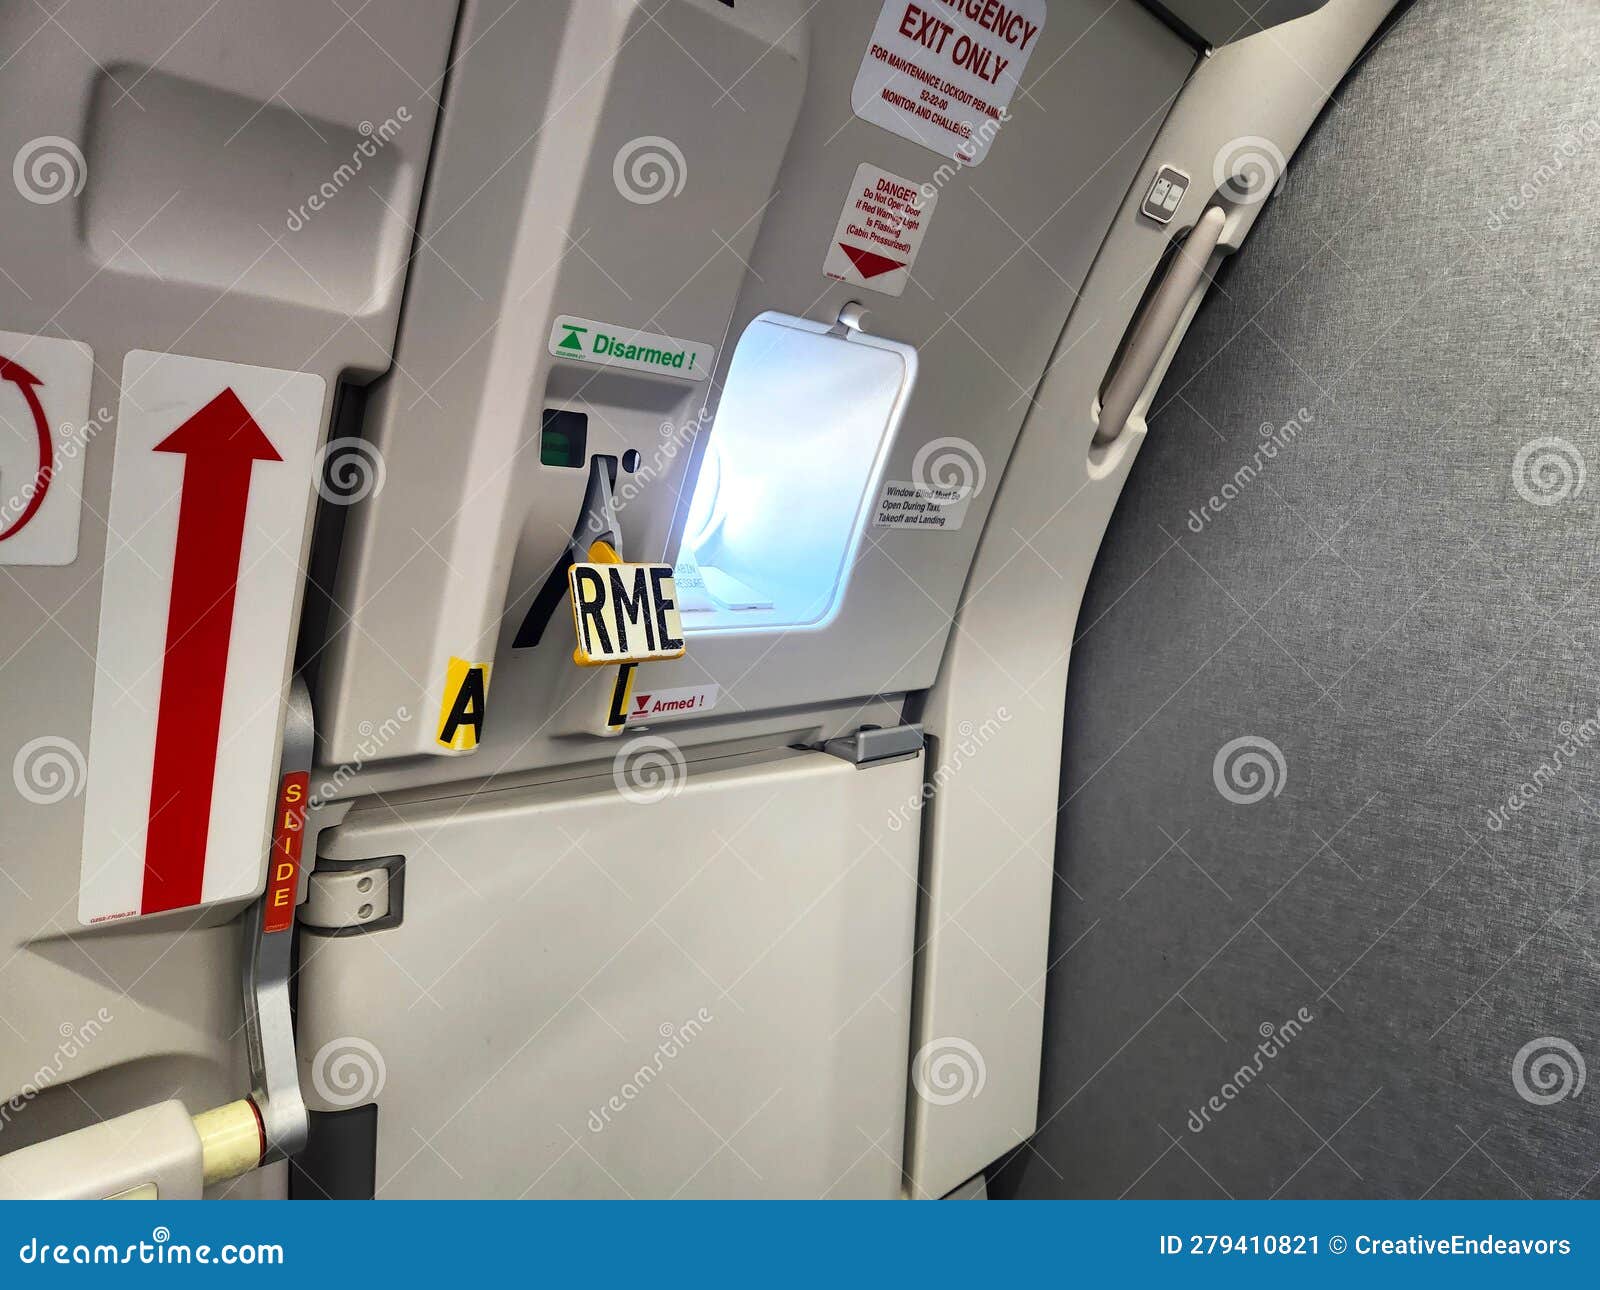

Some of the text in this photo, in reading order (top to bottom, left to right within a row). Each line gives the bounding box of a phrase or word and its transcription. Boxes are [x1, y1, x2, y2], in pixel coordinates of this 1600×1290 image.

[942, 0, 1037, 50] GENCY
[899, 3, 1008, 84] EXIT ONLY
[870, 44, 888, 63] FOR
[888, 53, 940, 89] MAINTENANCE
[940, 80, 973, 105] LOCKOUT
[973, 97, 986, 112] PER
[881, 89, 916, 113] MONITOR
[914, 103, 932, 121] AND
[920, 89, 948, 111] 52-22-00
[863, 188, 873, 200] Do
[875, 192, 886, 204] Not
[904, 205, 921, 217] Door
[876, 178, 917, 204] DANGER
[862, 201, 875, 214] Red
[902, 217, 919, 231] Light
[592, 333, 696, 370] Disarmed !
[882, 500, 901, 510] Open
[902, 501, 925, 513] During
[887, 486, 915, 498] Window
[878, 513, 946, 526] Takeoff and Landing
[575, 567, 684, 655] RME
[440, 668, 485, 745] A
[651, 696, 695, 713] Armed
[273, 783, 302, 907] SLIDE
